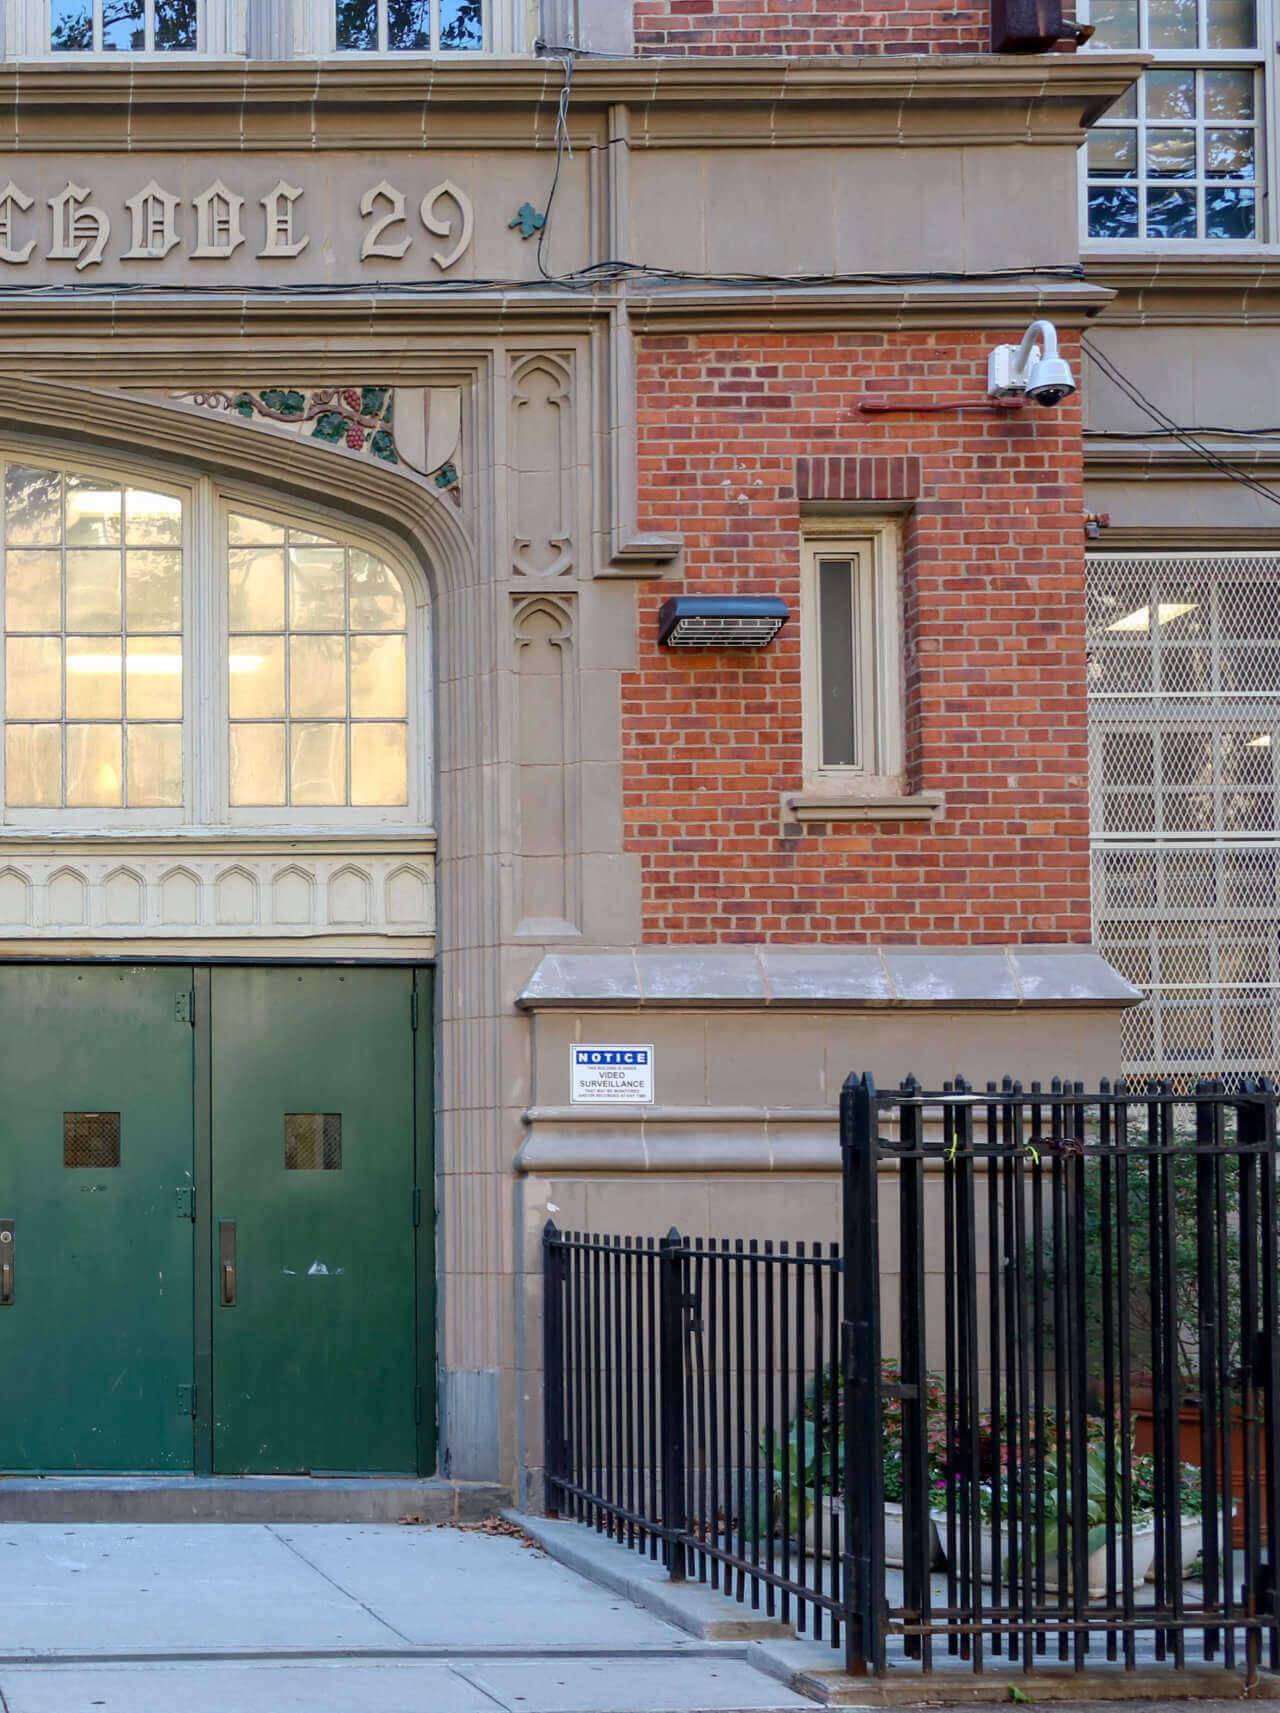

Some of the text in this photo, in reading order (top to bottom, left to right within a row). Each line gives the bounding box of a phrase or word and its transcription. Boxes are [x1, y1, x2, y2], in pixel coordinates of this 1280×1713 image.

[359, 178, 475, 270] 29
[578, 1053, 645, 1063] NOTICE
[599, 1071, 626, 1079] VIDEO
[579, 1080, 645, 1088] SURVEILLANCE
